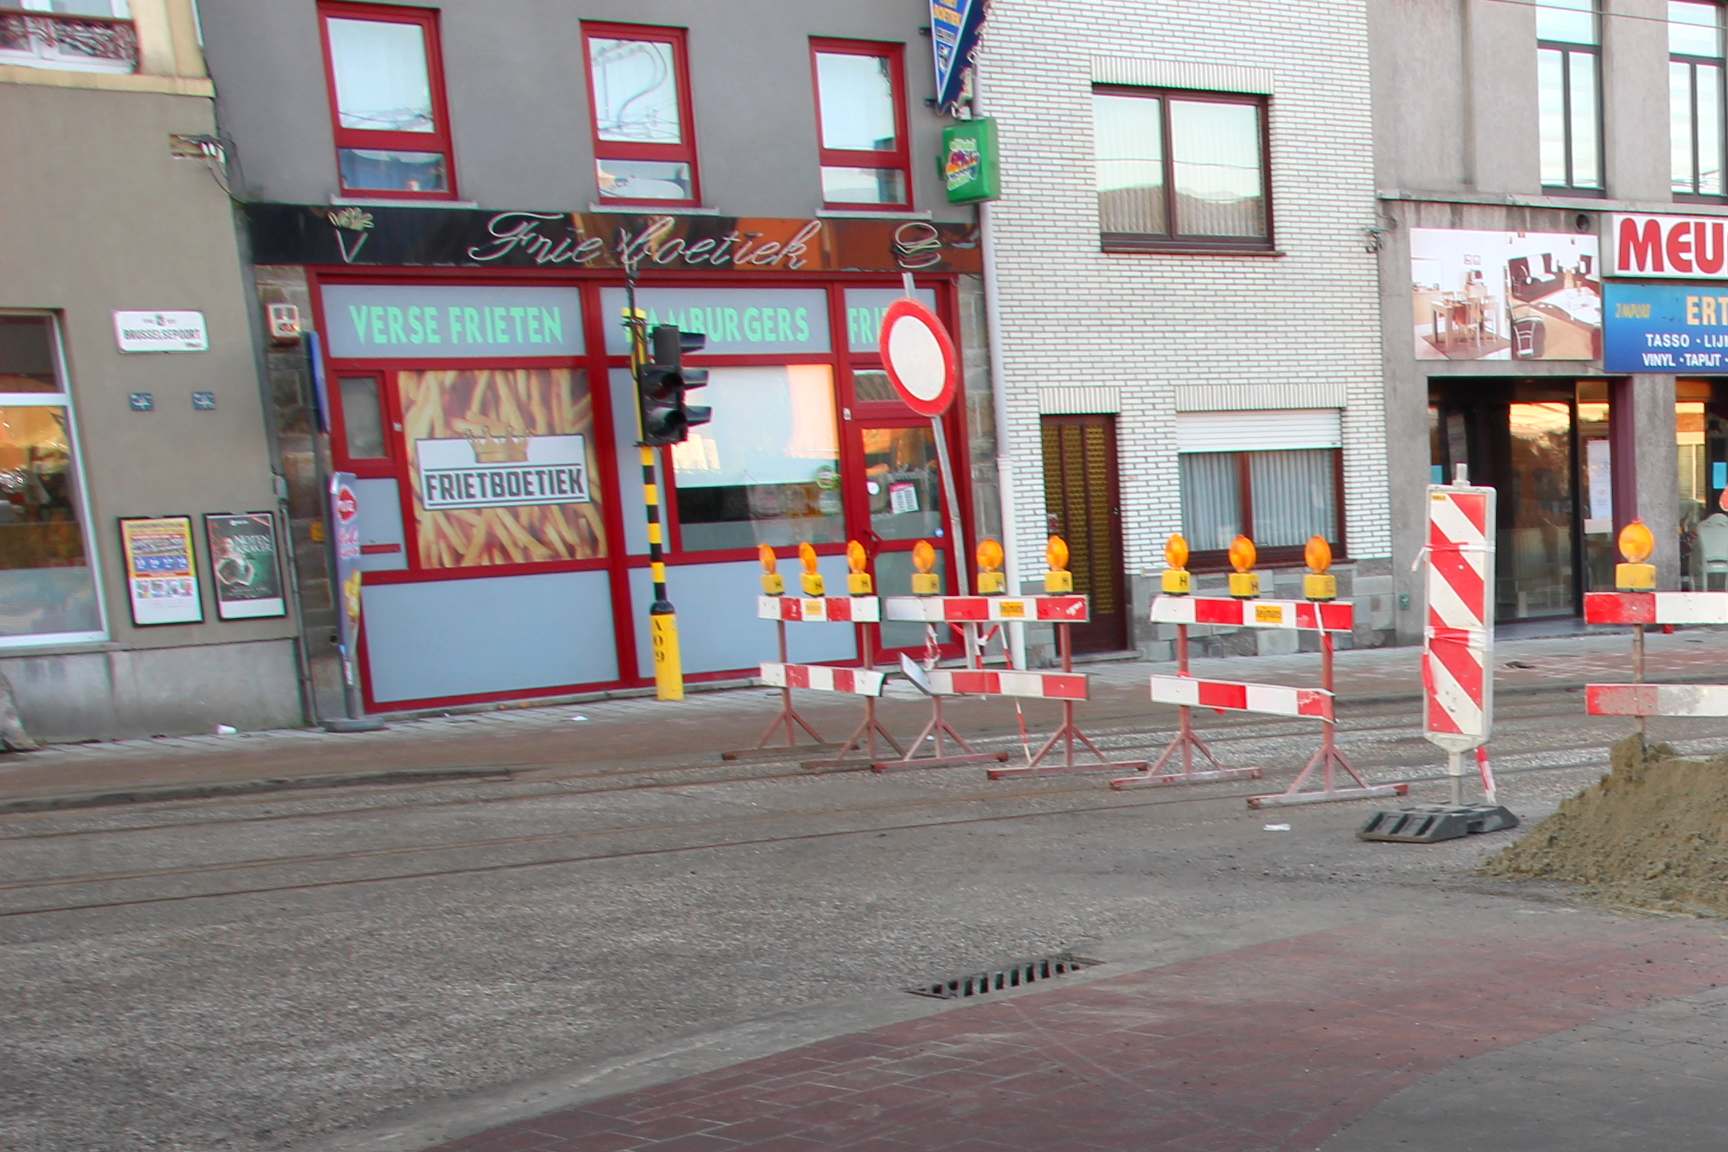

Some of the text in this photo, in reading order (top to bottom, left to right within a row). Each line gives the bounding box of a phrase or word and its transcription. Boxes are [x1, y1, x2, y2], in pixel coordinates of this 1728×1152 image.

[349, 305, 564, 345] VERSE FRIETEN
[624, 305, 810, 343] AMBURGERS
[1645, 334, 1690, 347] TASSO
[1642, 353, 1676, 367] VINYL
[1684, 354, 1722, 367] TAPIJT
[425, 470, 584, 501] FRIETBOETIEK
